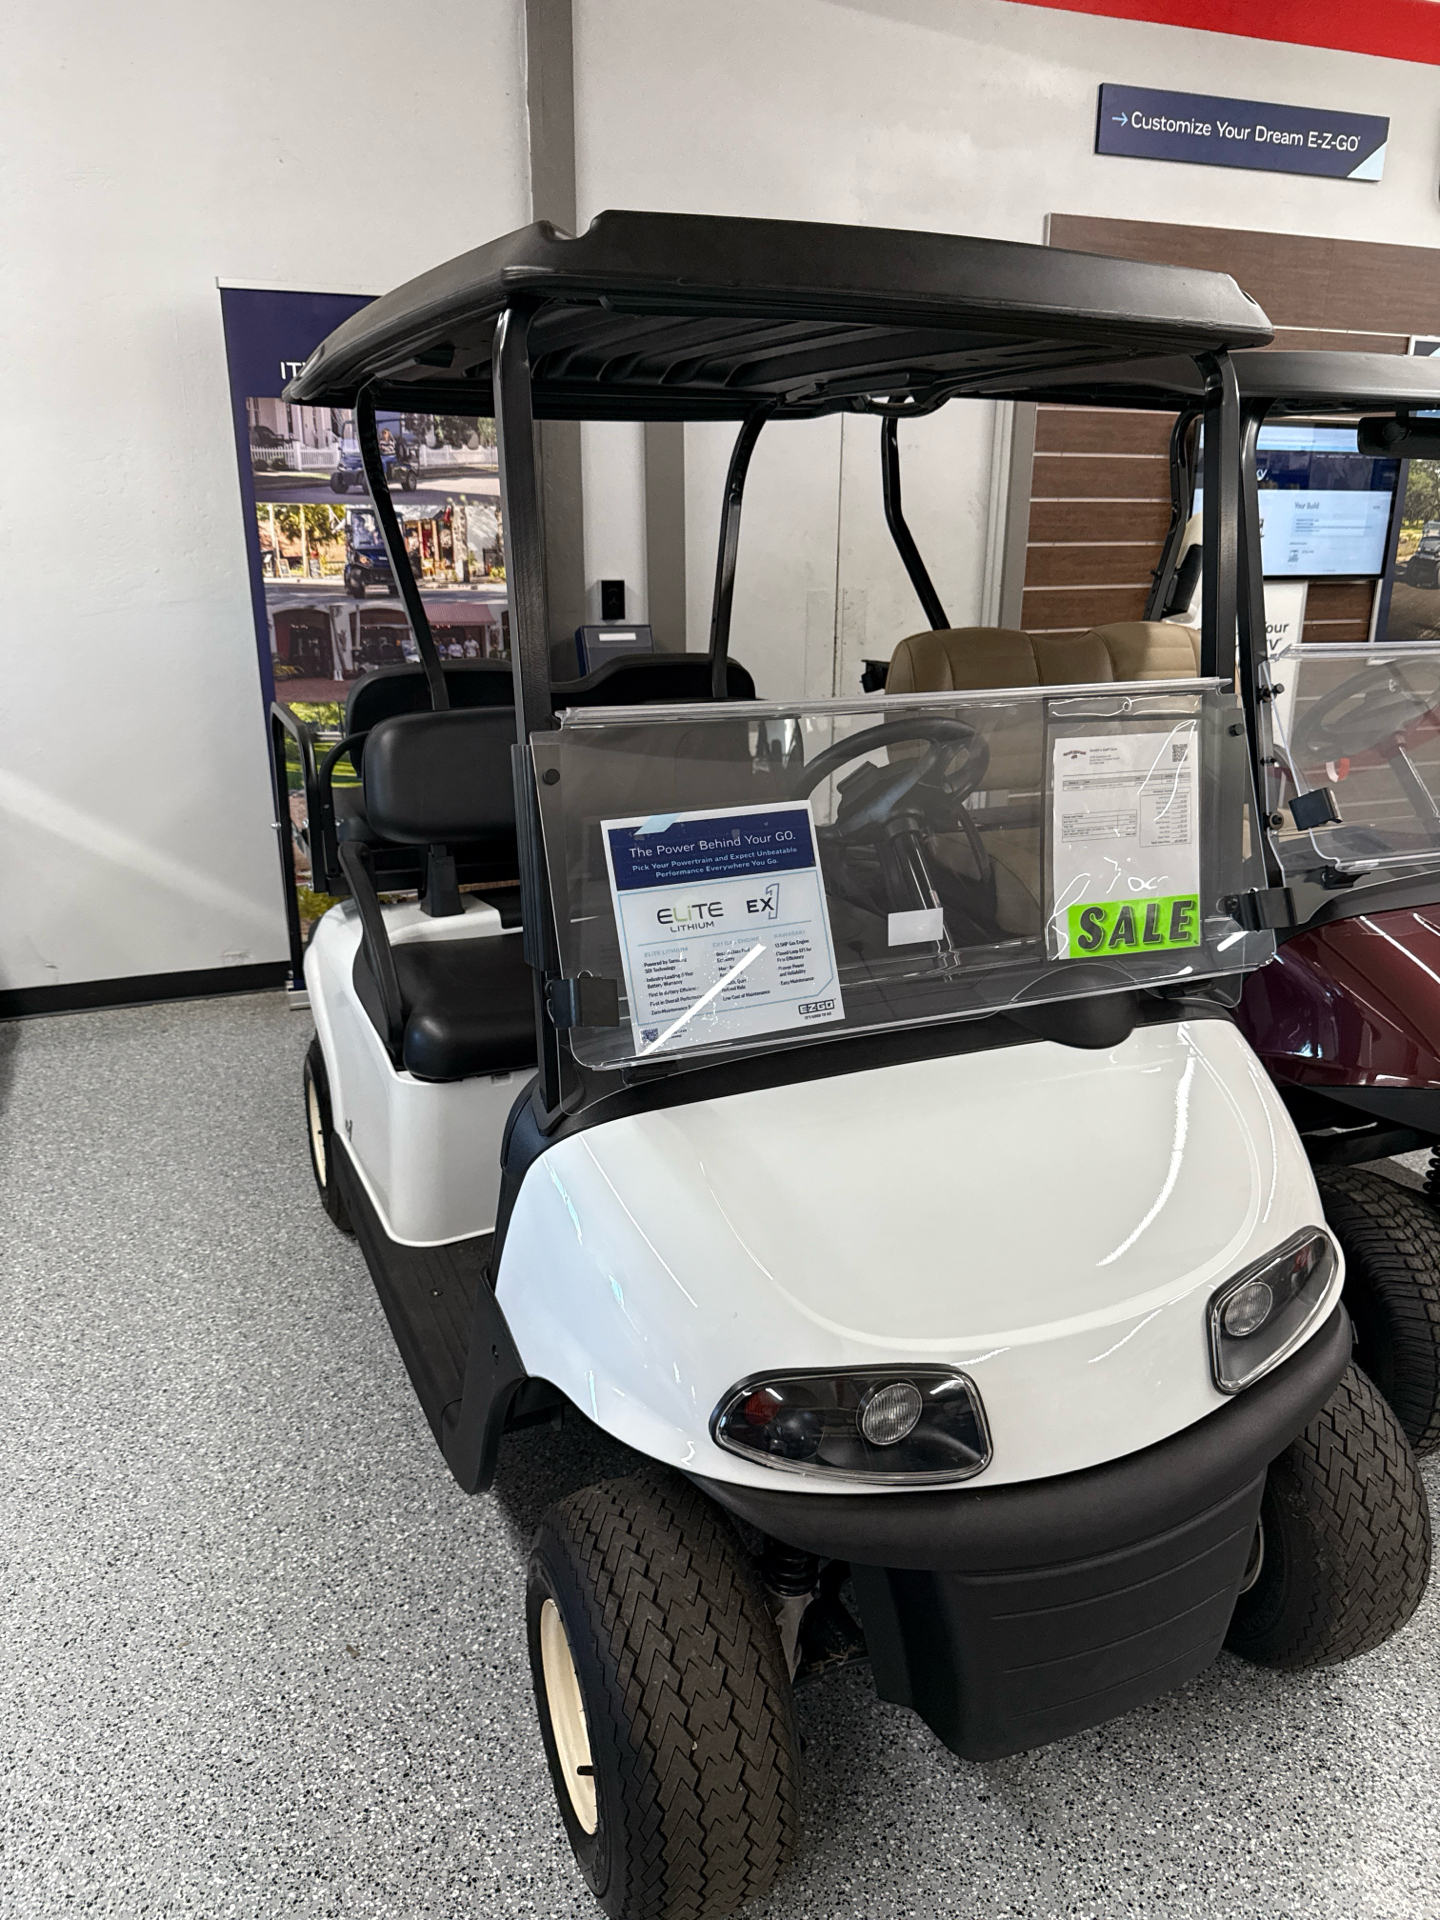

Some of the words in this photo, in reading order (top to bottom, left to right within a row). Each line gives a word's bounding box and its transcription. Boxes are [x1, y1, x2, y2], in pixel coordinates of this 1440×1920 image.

[1131, 111, 1212, 136] Customize
[1216, 121, 1251, 140] Your
[1255, 125, 1303, 146] Dream
[1308, 131, 1360, 152] E-Z-GO
[1265, 622, 1289, 633] our
[629, 848, 653, 858] The
[657, 844, 696, 855] Power
[700, 837, 741, 850] Behind
[744, 834, 771, 845] Your
[775, 830, 796, 842] GO.
[632, 863, 650, 872] Pick
[671, 856, 712, 867] Powertrain
[730, 852, 755, 861] Expect
[756, 847, 798, 857] Unbeatable
[655, 868, 704, 878] Performance
[706, 862, 750, 873] Everywhere
[751, 859, 765, 867] You
[746, 883, 780, 920] EX1
[670, 921, 714, 932] LITHIUM
[774, 930, 806, 939] KAWASAKI
[1078, 900, 1193, 952] SALE
[799, 1000, 834, 1014] EZGO
